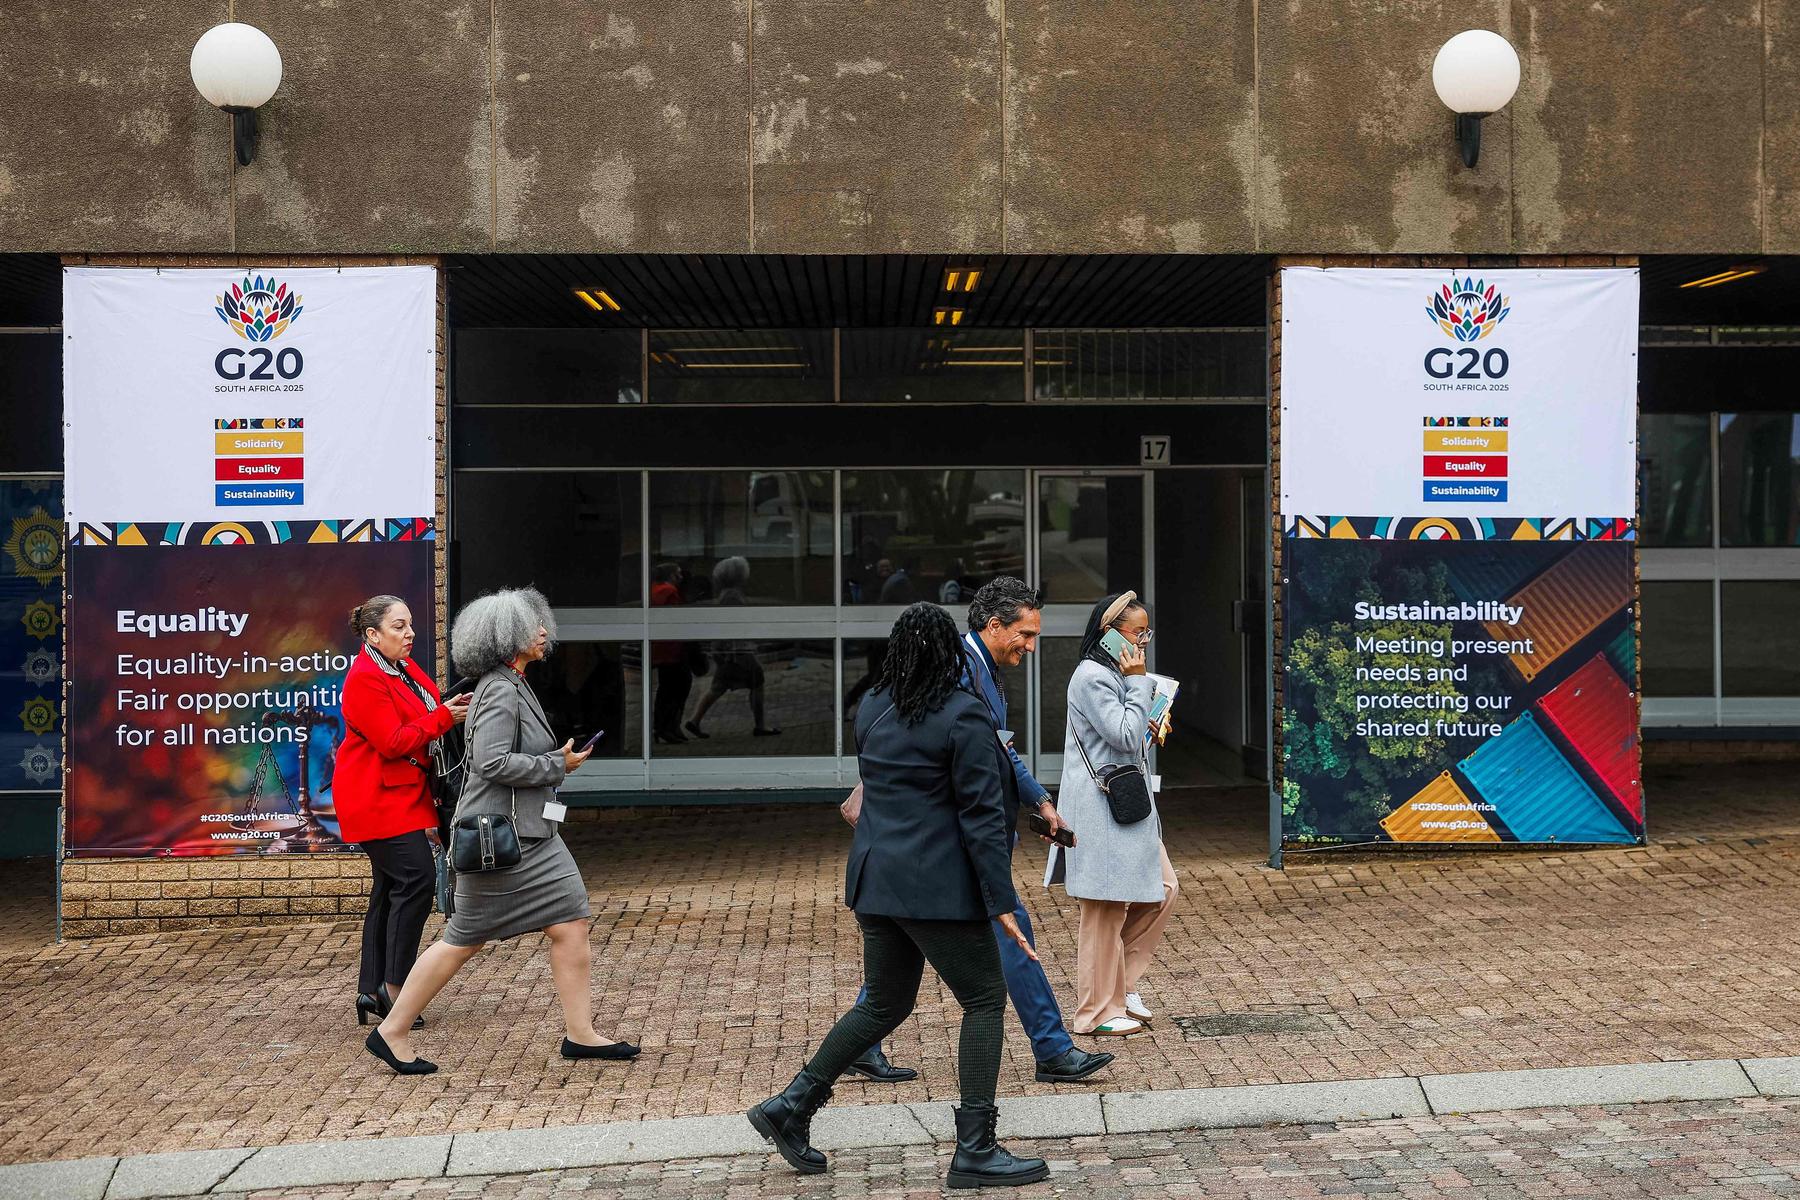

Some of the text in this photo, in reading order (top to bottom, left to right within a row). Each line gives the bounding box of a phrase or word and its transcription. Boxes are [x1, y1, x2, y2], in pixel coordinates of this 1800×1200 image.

[214, 347, 304, 381] G20
[1424, 347, 1510, 379] G20
[214, 384, 304, 393] SOUTH AFRICA 2025
[1423, 383, 1453, 391] SOUTH
[1455, 383, 1488, 391] AFRICA
[234, 439, 284, 450] Solidarity
[1442, 437, 1490, 448] Solidarity
[1144, 440, 1167, 460] 17
[238, 464, 281, 475] Equality
[1445, 461, 1486, 472] Equality
[224, 489, 296, 500] Sustainability
[1431, 486, 1500, 497] Sustainability
[1354, 600, 1524, 626] Sustainability
[116, 606, 249, 638] Equality
[1355, 635, 1534, 657] Meeting present
[1355, 663, 1468, 682] needs and
[117, 684, 343, 715] Fair opportuniti
[1356, 692, 1512, 713] protecting our
[116, 721, 308, 746] for all nations
[1355, 719, 1503, 737] shared future
[1410, 802, 1497, 812] #G20SouthAfrica
[200, 812, 290, 823] #G20SouthAfrica
[1420, 820, 1488, 830] www.g20.org
[210, 830, 281, 841] www.g20.org
